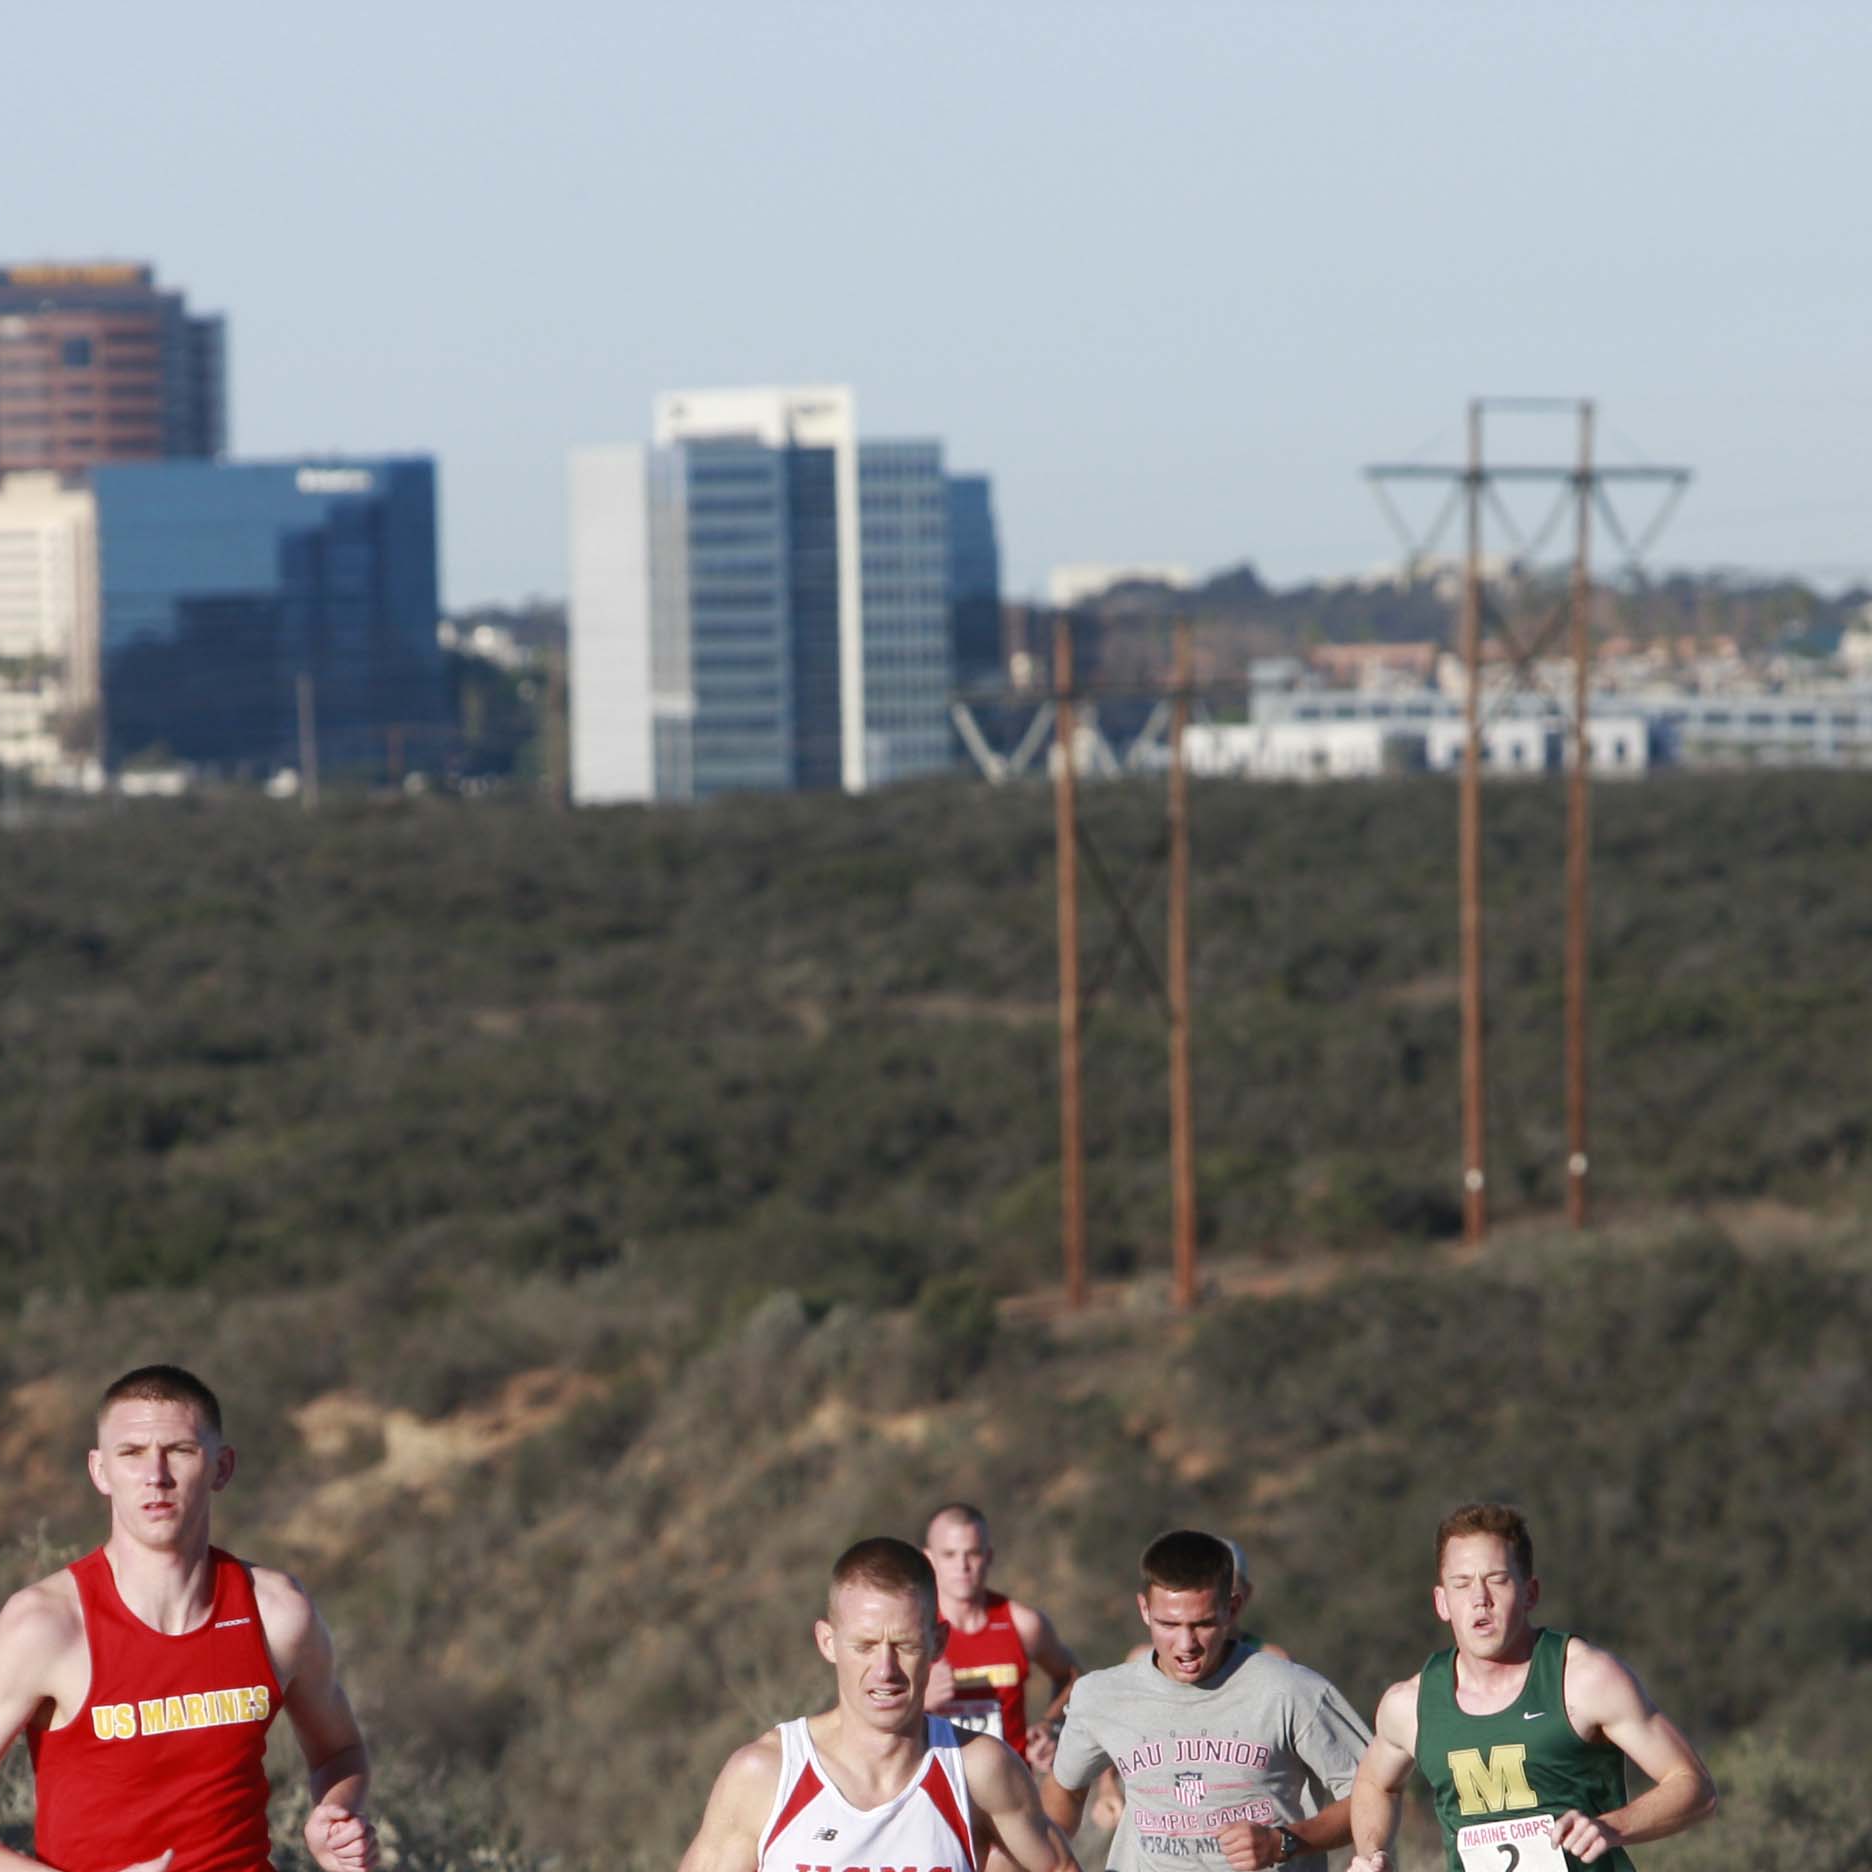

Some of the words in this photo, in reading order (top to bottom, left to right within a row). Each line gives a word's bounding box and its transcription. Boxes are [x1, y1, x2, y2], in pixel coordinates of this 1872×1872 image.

[91, 1703, 137, 1740] US
[138, 1685, 270, 1736] MARINES
[1117, 1742, 1164, 1777] AAU
[1175, 1738, 1270, 1769] JUNIOR
[1447, 1744, 1538, 1816] M
[1206, 1800, 1272, 1827] GAMES
[1195, 1836, 1221, 1855] AN
[1463, 1826, 1507, 1848] MARINE
[1510, 1821, 1550, 1841] CORPS
